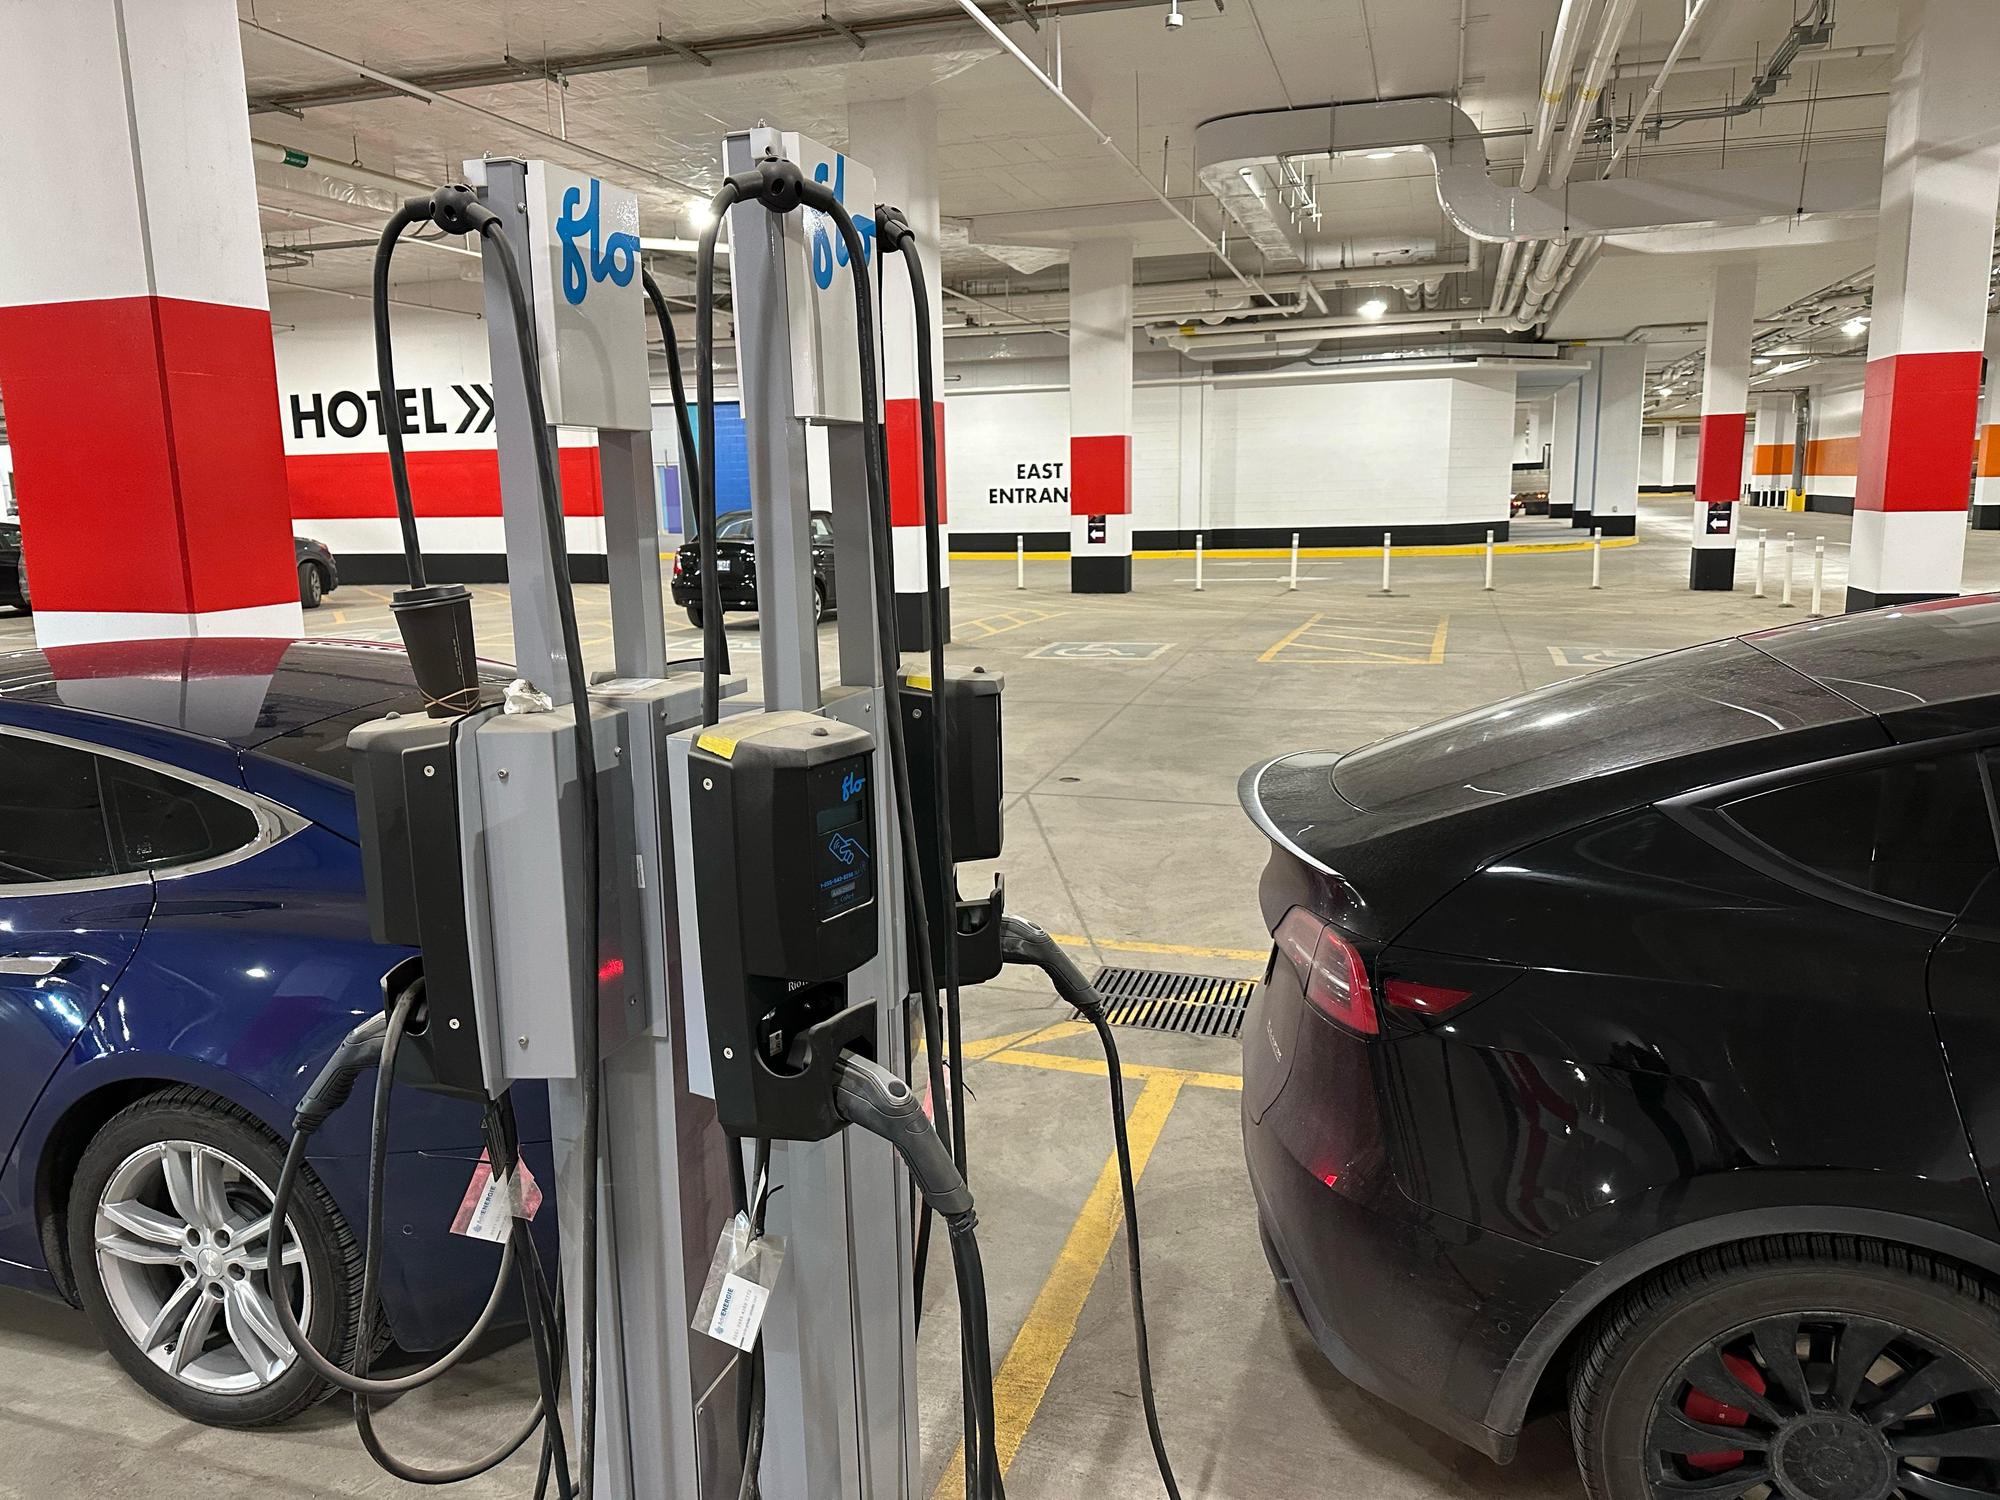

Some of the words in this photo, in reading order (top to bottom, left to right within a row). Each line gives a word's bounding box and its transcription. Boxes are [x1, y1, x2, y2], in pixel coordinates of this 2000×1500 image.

[556, 177, 641, 306] flo
[289, 387, 448, 439] HOTEL
[1017, 462, 1063, 480] EAST
[989, 487, 1072, 504] ENTRAN
[842, 771, 866, 802] flo
